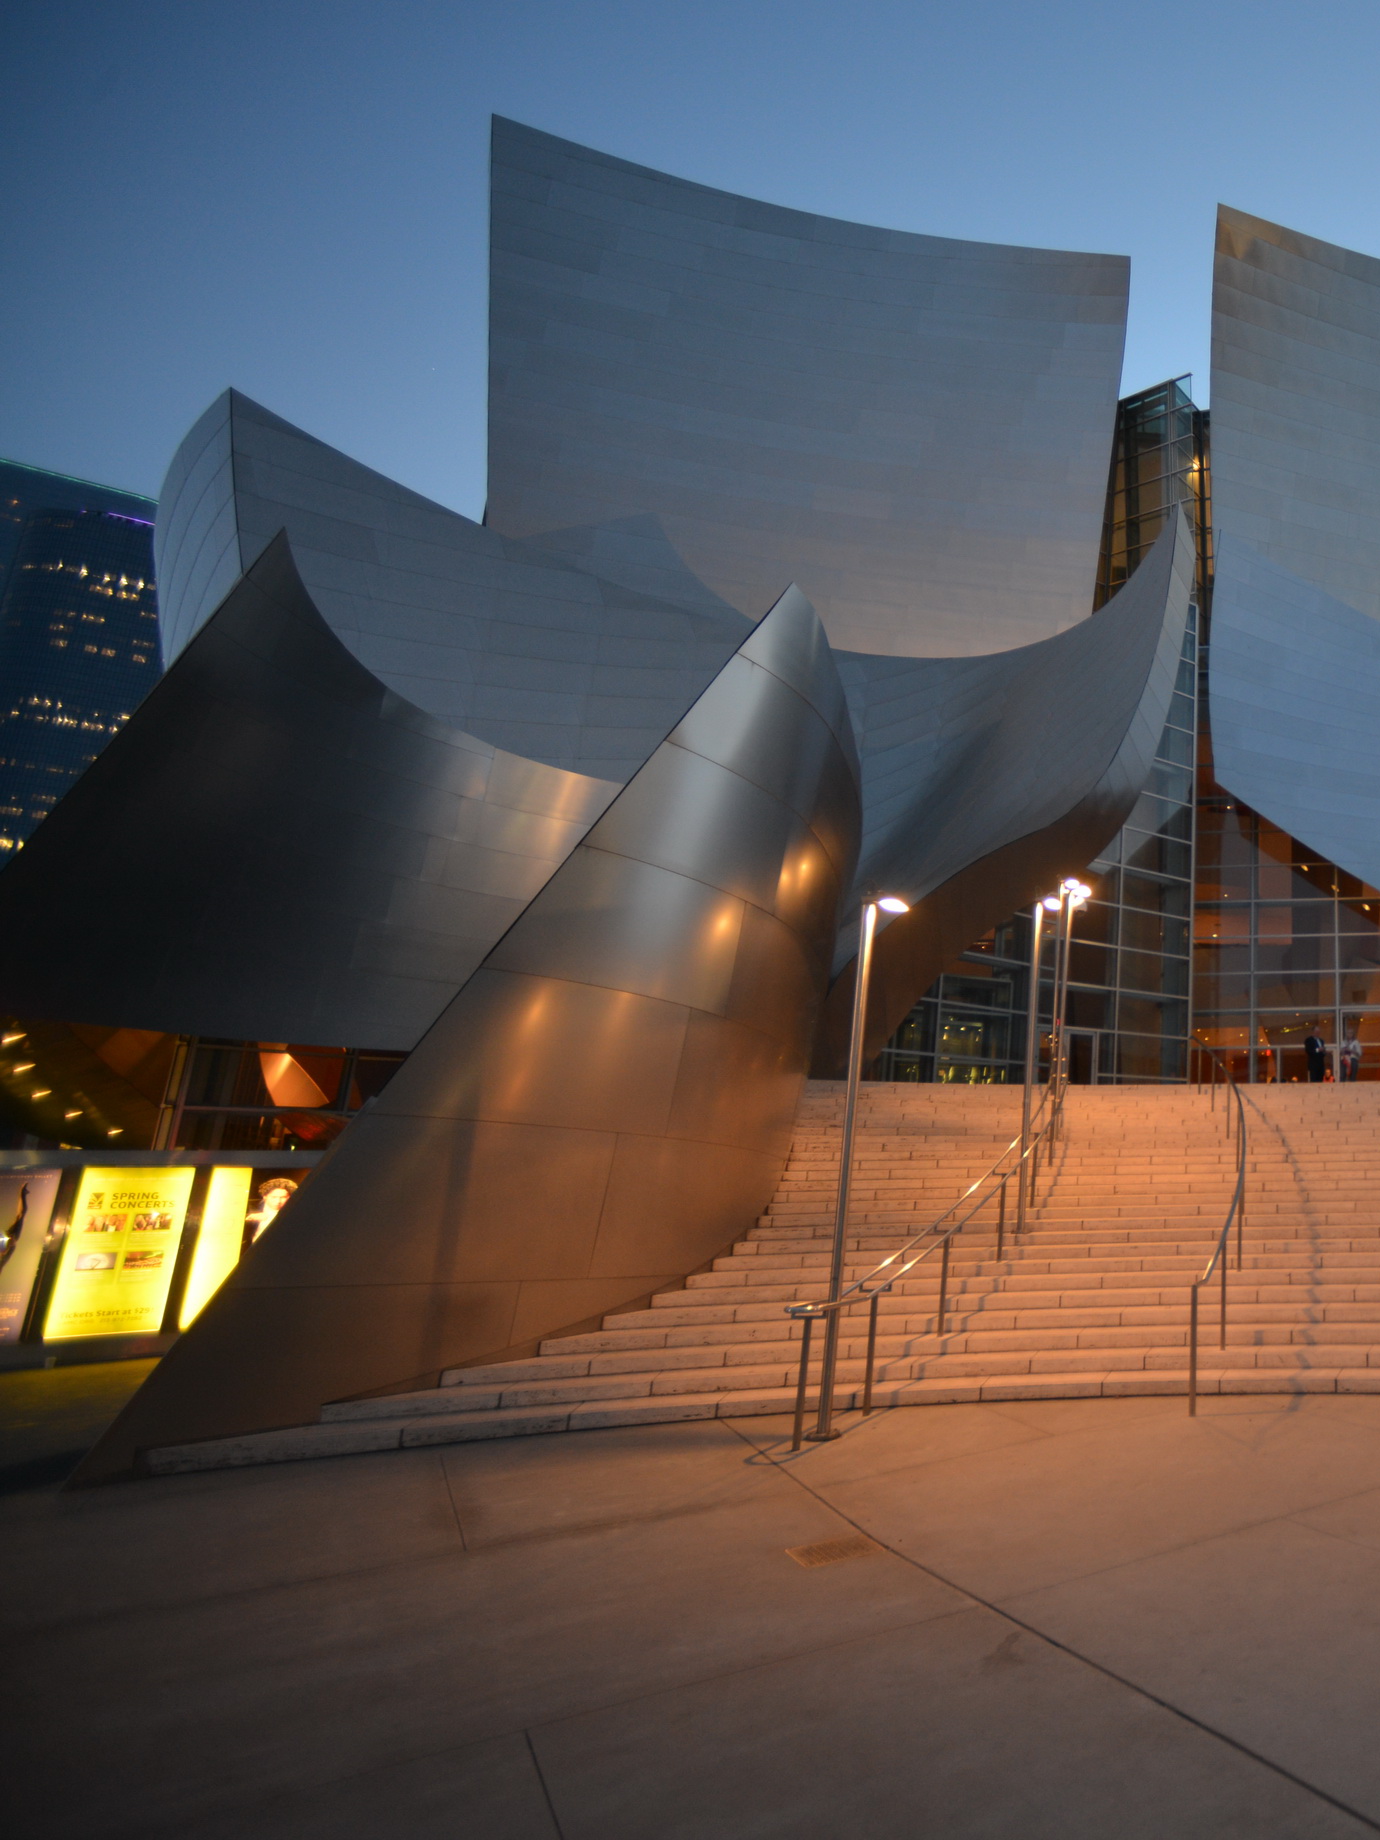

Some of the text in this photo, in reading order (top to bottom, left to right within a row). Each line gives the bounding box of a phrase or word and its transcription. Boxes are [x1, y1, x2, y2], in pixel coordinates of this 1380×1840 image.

[112, 1192, 159, 1200] SPRING
[110, 1200, 175, 1209] CONCERTS
[61, 1311, 94, 1319] Tickets
[96, 1309, 120, 1317] Start
